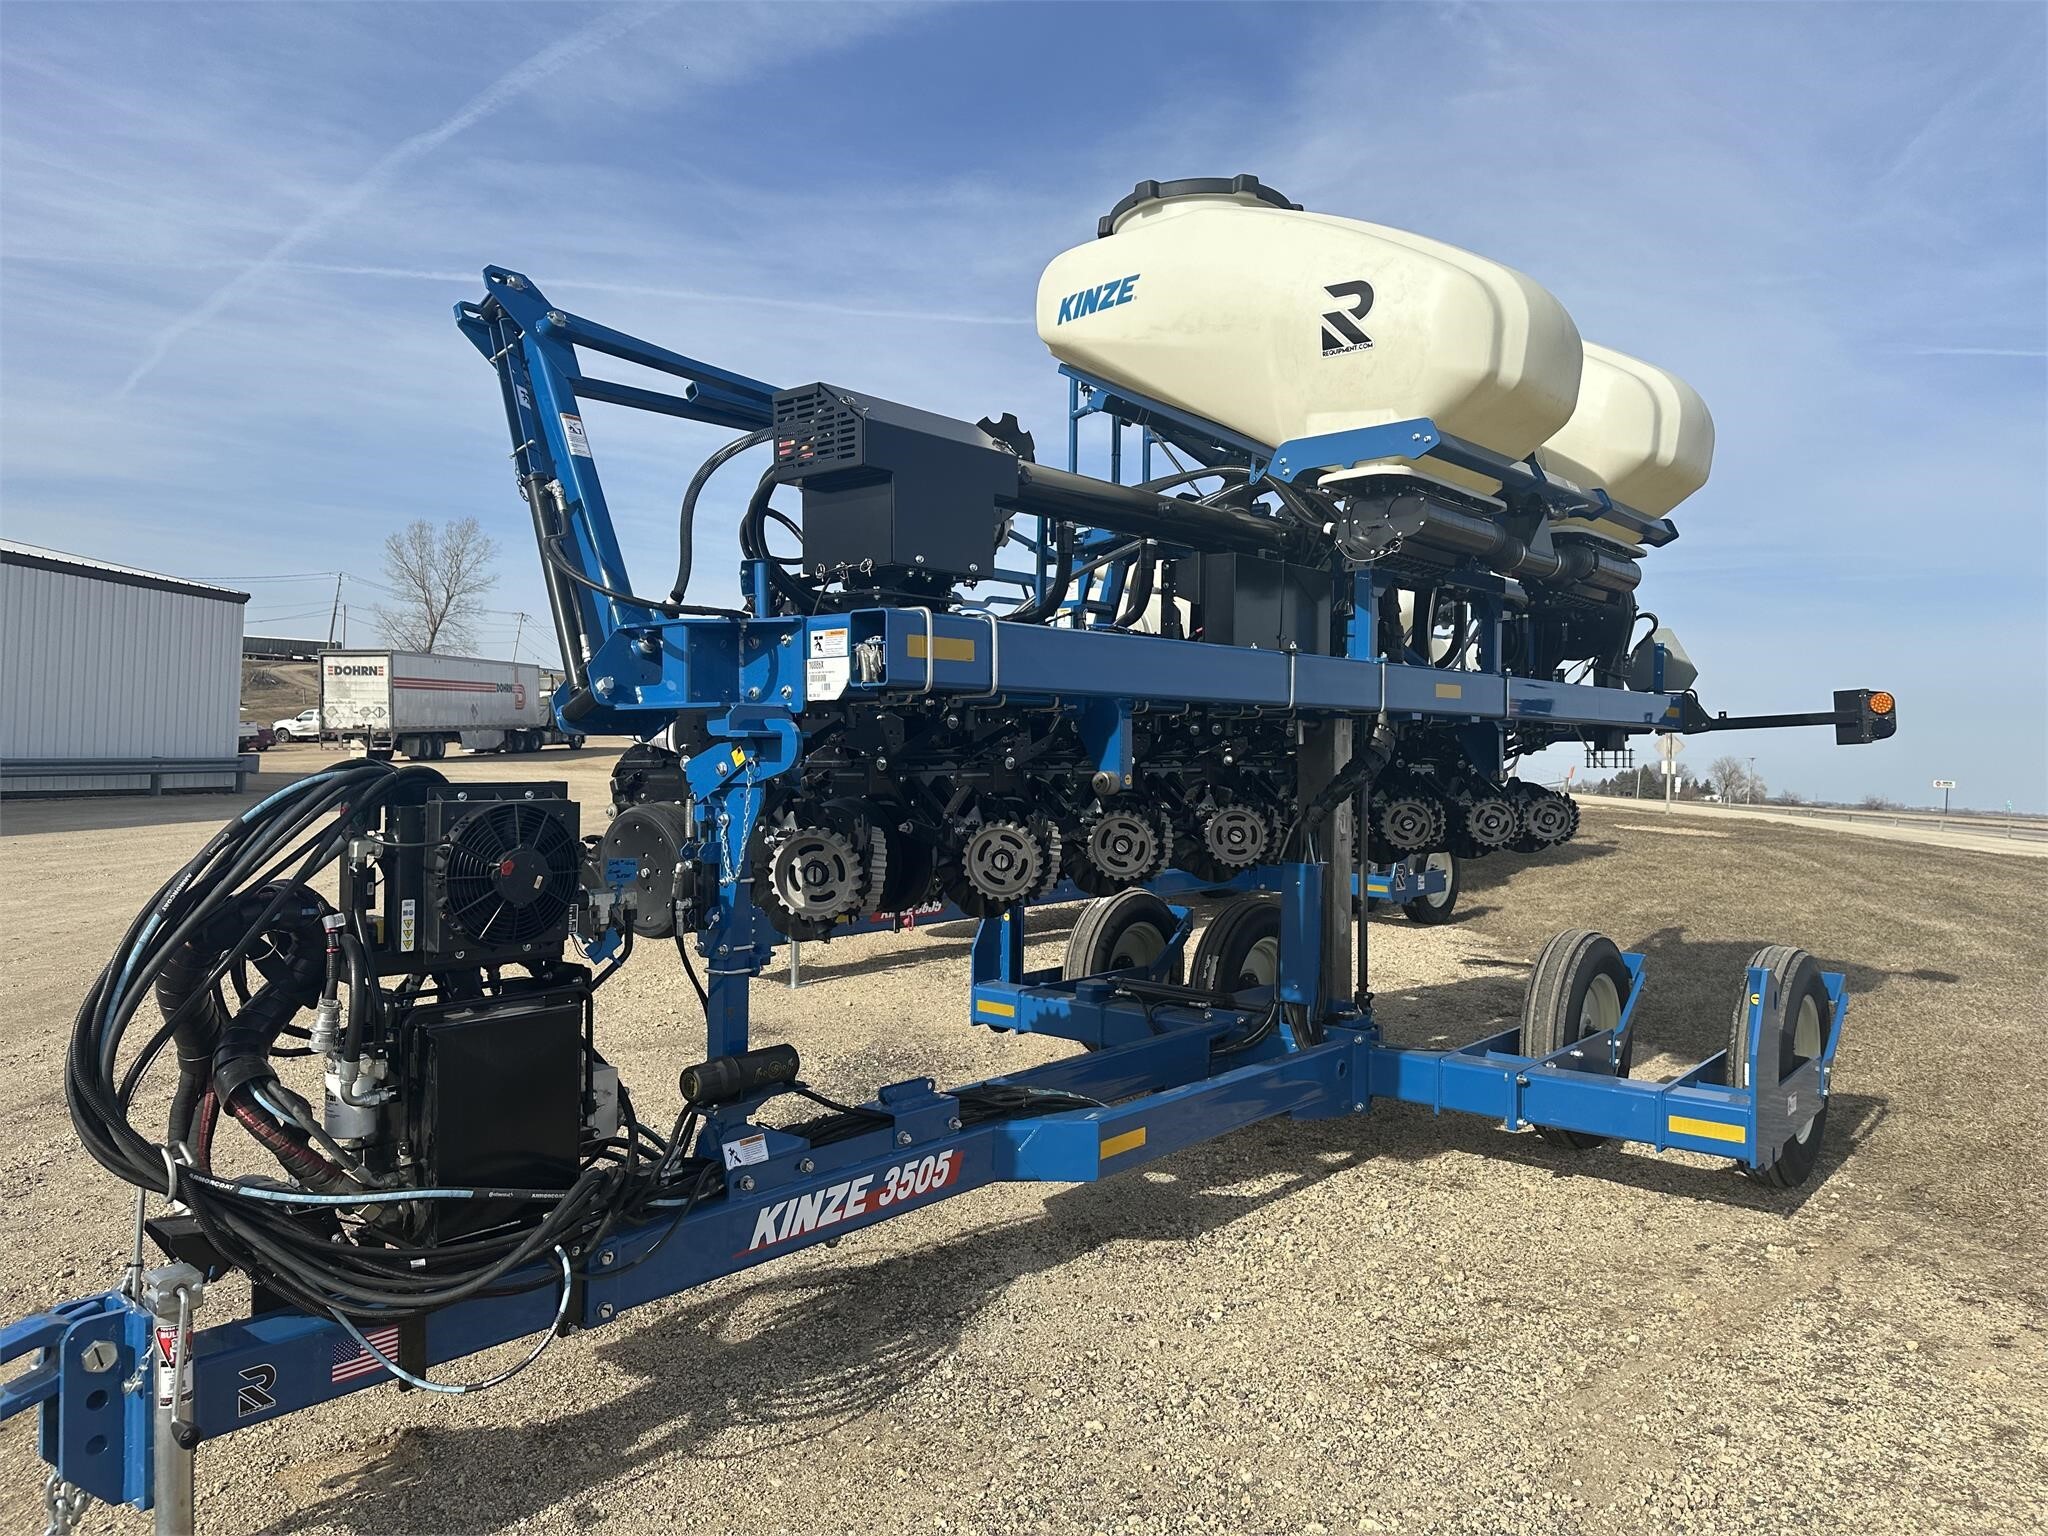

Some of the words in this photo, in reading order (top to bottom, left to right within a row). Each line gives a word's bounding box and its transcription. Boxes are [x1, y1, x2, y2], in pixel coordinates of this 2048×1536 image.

[1057, 273, 1141, 326] KINZE
[1322, 342, 1374, 357] REQUIPMENT.COM
[334, 665, 378, 676] DOHRN
[161, 872, 193, 912] ARMORCOAT
[188, 1173, 235, 1191] ARMORCOAT
[748, 1173, 875, 1251] KINZE
[878, 1148, 954, 1207] 3505
